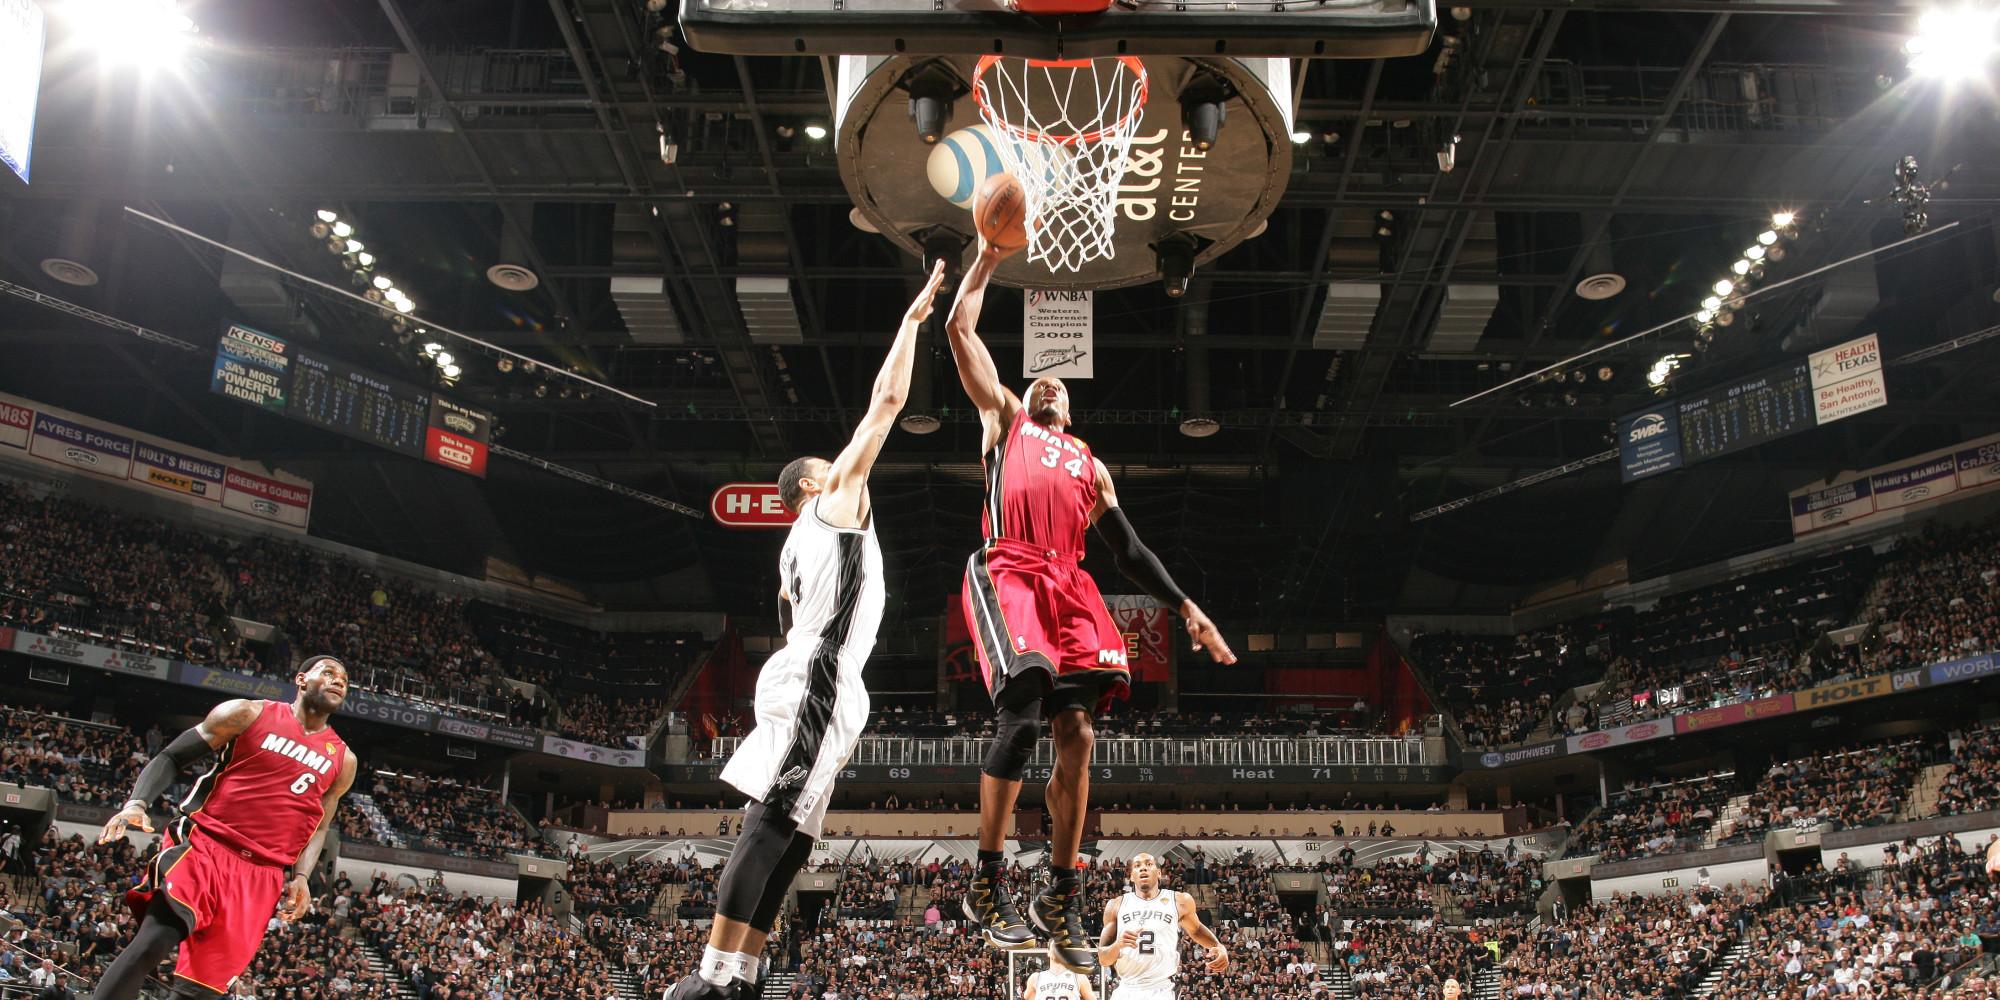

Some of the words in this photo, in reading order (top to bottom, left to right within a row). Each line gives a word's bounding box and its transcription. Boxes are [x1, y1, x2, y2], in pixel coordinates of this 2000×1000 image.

[1044, 291, 1088, 301] WNBA
[224, 345, 285, 372] WEATHER
[1835, 341, 1876, 362] HEALTH
[1837, 352, 1877, 372] TEXAS
[224, 361, 246, 376] SA's
[249, 368, 279, 386] MOST
[297, 354, 329, 371] Spurs
[350, 372, 363, 383] 69
[1742, 379, 1767, 393] Heat
[1794, 365, 1806, 375] 71
[216, 369, 284, 400] POWERFUL
[224, 384, 264, 405] RADAR
[365, 377, 390, 393] Heat
[417, 394, 429, 405] 71
[1821, 390, 1834, 400] Be
[1836, 378, 1876, 394] Healthy,
[1680, 398, 1709, 412] Spurs
[1728, 387, 1740, 397] 69
[1819, 400, 1839, 410] San
[1841, 387, 1880, 404] Antonio
[37, 420, 83, 441] AYRES
[85, 433, 130, 454] FORCE
[1020, 421, 1088, 462] MIAMI
[1629, 420, 1668, 443] SWBC
[139, 446, 176, 467] HOLT'S
[179, 459, 222, 479] HEROES
[1040, 446, 1083, 479] 34
[151, 472, 190, 487] HOLT
[1873, 473, 1909, 489] MANU'S
[1911, 460, 1954, 480] MANIACS
[228, 474, 268, 494] GREEN'S
[269, 484, 309, 504] GOBLINS
[726, 493, 784, 514] H-E
[51, 647, 84, 658] LOOP
[126, 660, 157, 671] LOOP
[202, 670, 254, 691] Express
[253, 681, 284, 697] Lube
[1810, 680, 1882, 705] HOLT
[1893, 671, 1921, 690] CAT
[260, 733, 333, 775] MIAMI
[1505, 744, 1556, 763] SOUTHWEST
[290, 772, 317, 795] 6
[889, 768, 910, 779] 69
[1024, 768, 1051, 779] 1:5
[1102, 768, 1112, 779] 3
[1232, 768, 1275, 779] Heat
[1311, 768, 1331, 779] 71
[815, 842, 829, 850] 113
[1523, 836, 1537, 845] 116
[1663, 878, 1679, 887] 117
[1122, 909, 1173, 924] SPURS
[1138, 930, 1155, 954] 2
[1040, 982, 1075, 992] SPURS
